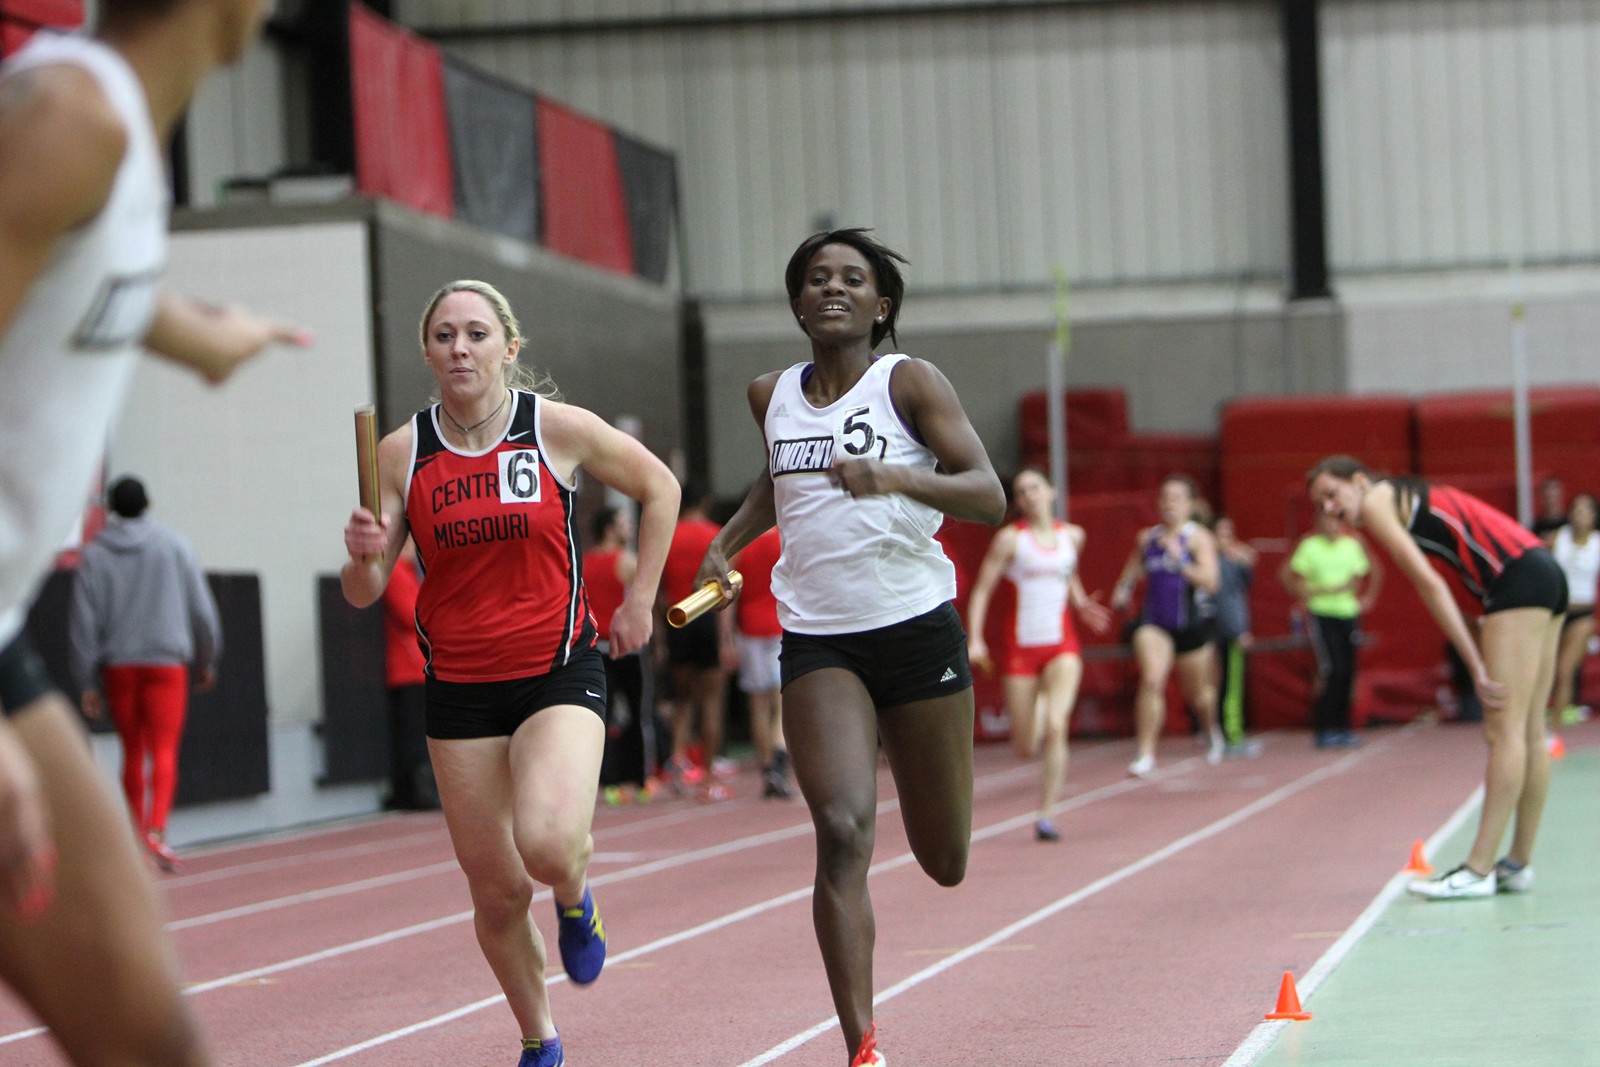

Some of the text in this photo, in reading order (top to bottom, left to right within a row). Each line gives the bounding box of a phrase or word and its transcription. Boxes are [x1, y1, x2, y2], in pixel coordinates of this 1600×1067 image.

[843, 405, 875, 456] 5
[432, 472, 501, 515] CENTR
[507, 451, 538, 498] 6
[433, 513, 529, 551] MISSOURI
